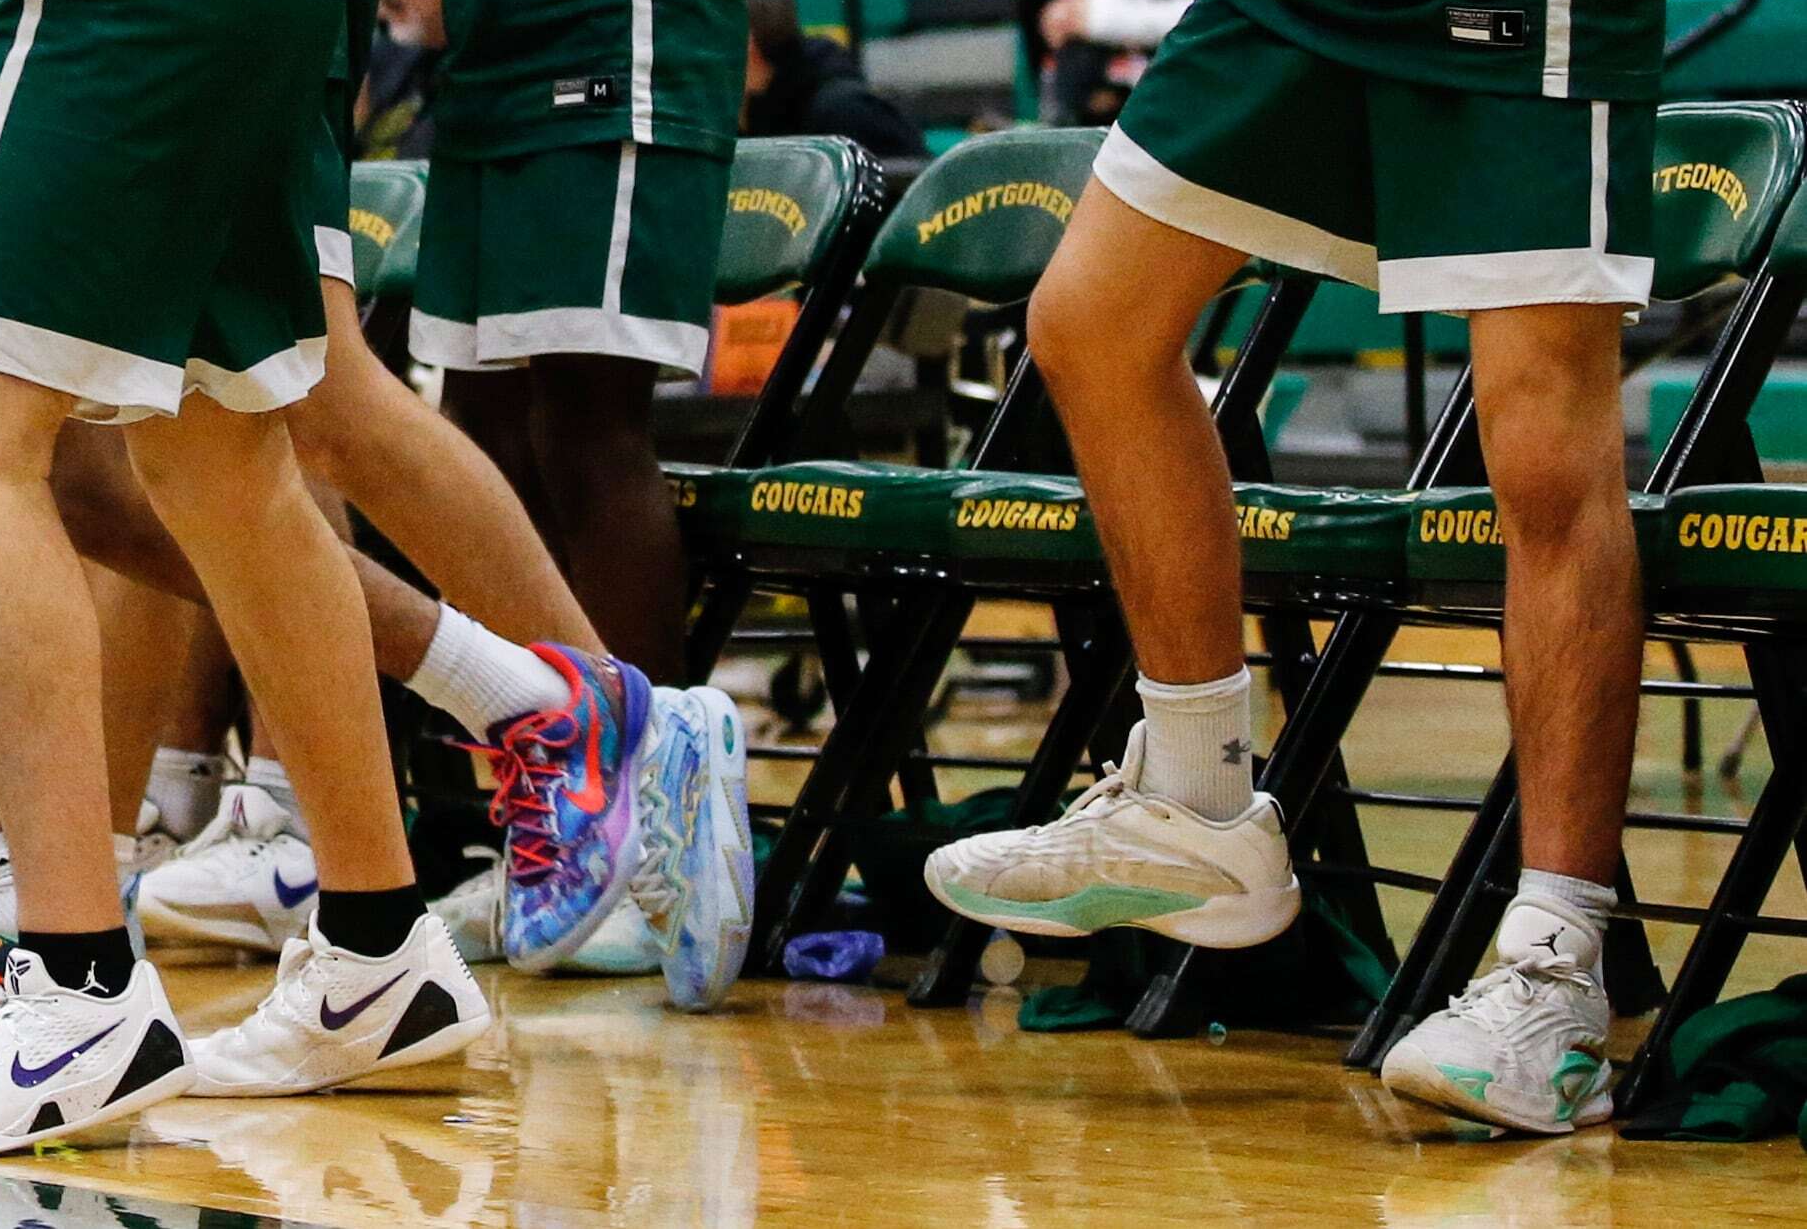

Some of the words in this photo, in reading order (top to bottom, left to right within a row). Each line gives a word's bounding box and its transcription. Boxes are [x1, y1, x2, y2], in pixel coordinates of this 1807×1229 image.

[1502, 21, 1514, 37] L
[593, 83, 607, 97] M
[1652, 163, 1748, 222] TGOMERY
[751, 481, 865, 519] COUGARS
[956, 498, 1080, 531] COUGARS
